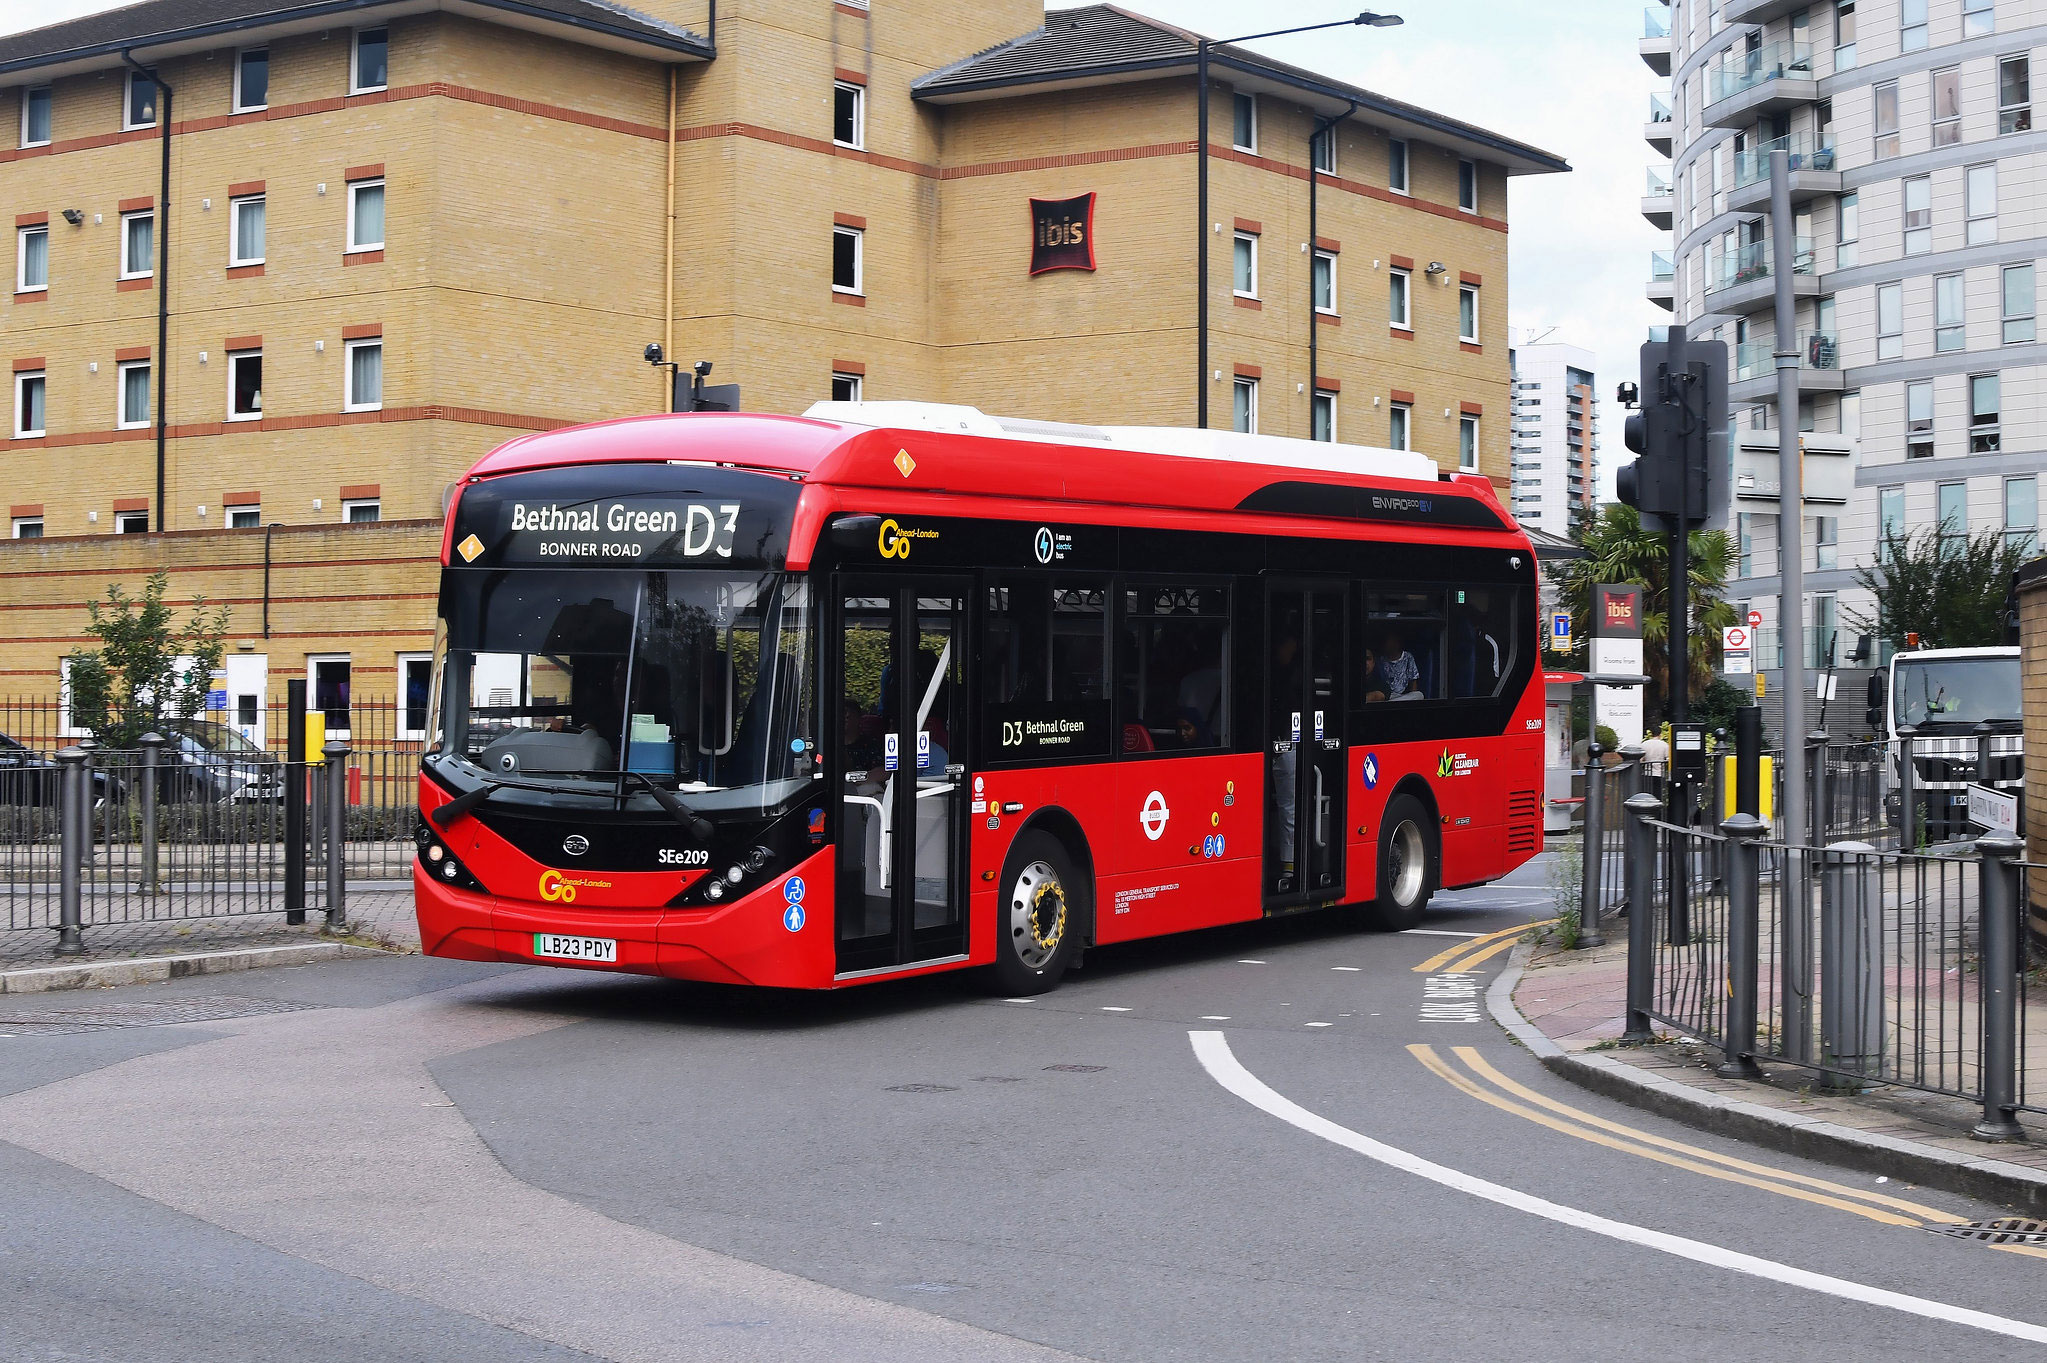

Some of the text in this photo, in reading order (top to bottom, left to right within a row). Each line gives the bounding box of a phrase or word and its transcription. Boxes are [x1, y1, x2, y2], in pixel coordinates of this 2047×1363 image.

[1039, 215, 1083, 247] ibis
[511, 503, 677, 532] Bethnal Green
[683, 504, 740, 558] D3
[878, 518, 939, 560] Go Ahead-London
[539, 542, 642, 557] BONNER ROAD
[1056, 551, 1065, 559] bus
[1607, 602, 1632, 618] ibis
[1002, 721, 1023, 746] D3
[1026, 719, 1085, 735] Bethnal Green
[1526, 719, 1542, 730] SEe209
[1039, 736, 1071, 745] BONNER ROAD
[658, 848, 709, 865] SEe209
[538, 869, 612, 903] Go Ahead-London
[543, 936, 612, 959] LB23 PDY
[1418, 1001, 1482, 1023] LOOK
